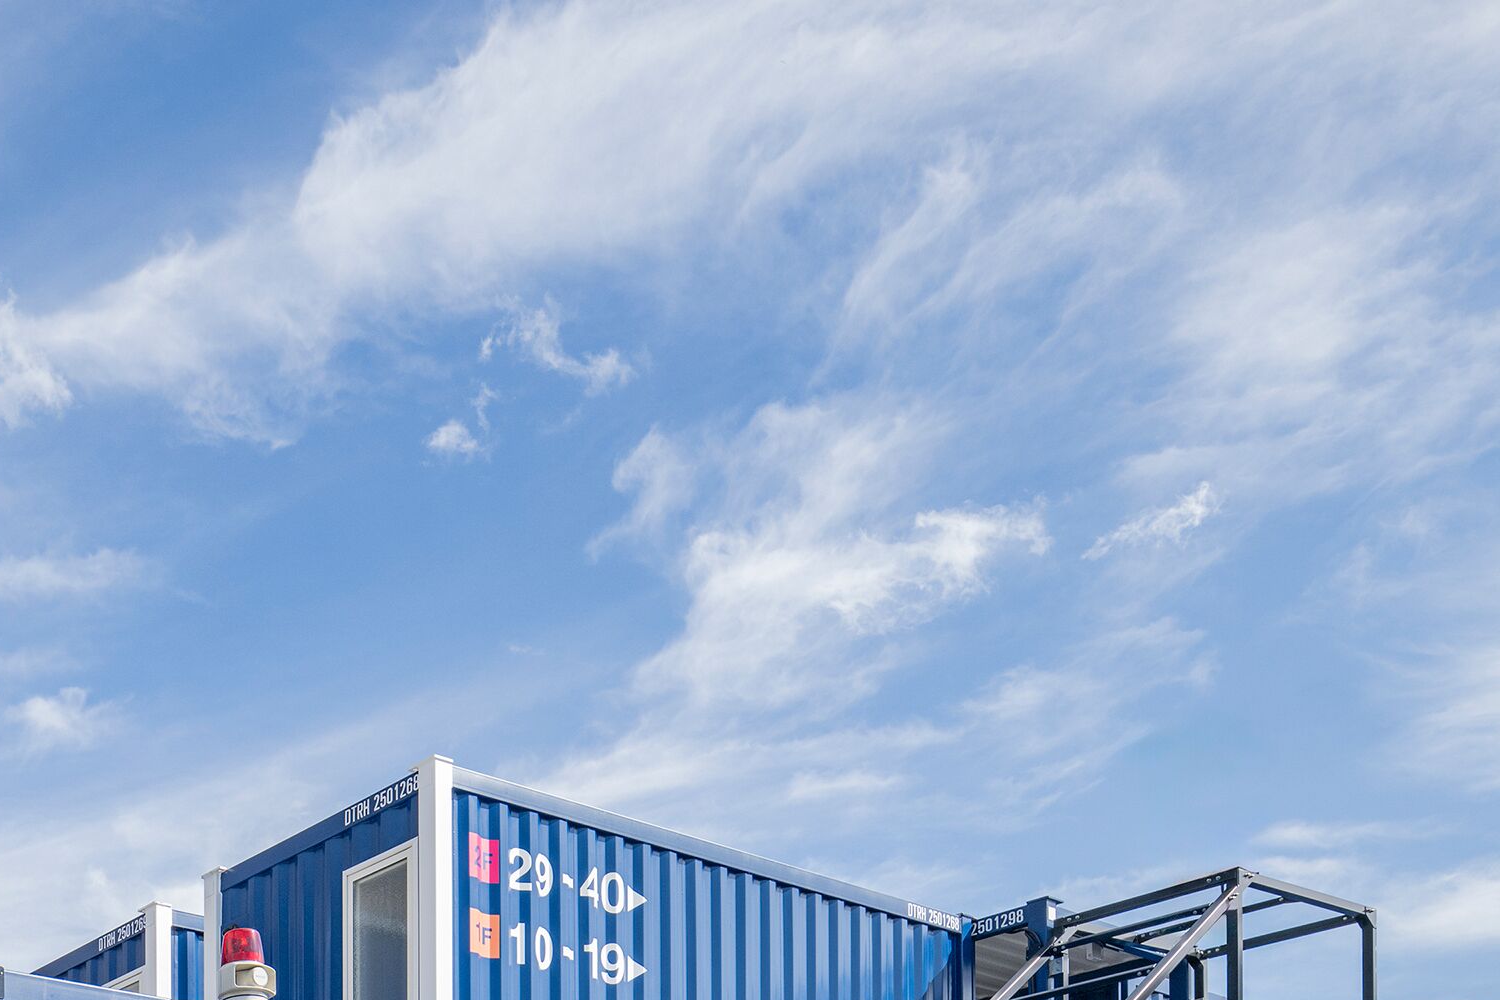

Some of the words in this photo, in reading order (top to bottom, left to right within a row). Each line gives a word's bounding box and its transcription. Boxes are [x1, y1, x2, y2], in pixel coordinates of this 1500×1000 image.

[344, 798, 370, 827] DTRH
[373, 773, 419, 812] 2501268
[473, 844, 494, 871] 2F
[907, 902, 927, 921] DTRH
[928, 909, 960, 931] 2501268
[970, 909, 1024, 937] 2501298
[98, 931, 116, 952] DTRH
[475, 921, 493, 946] 1F
